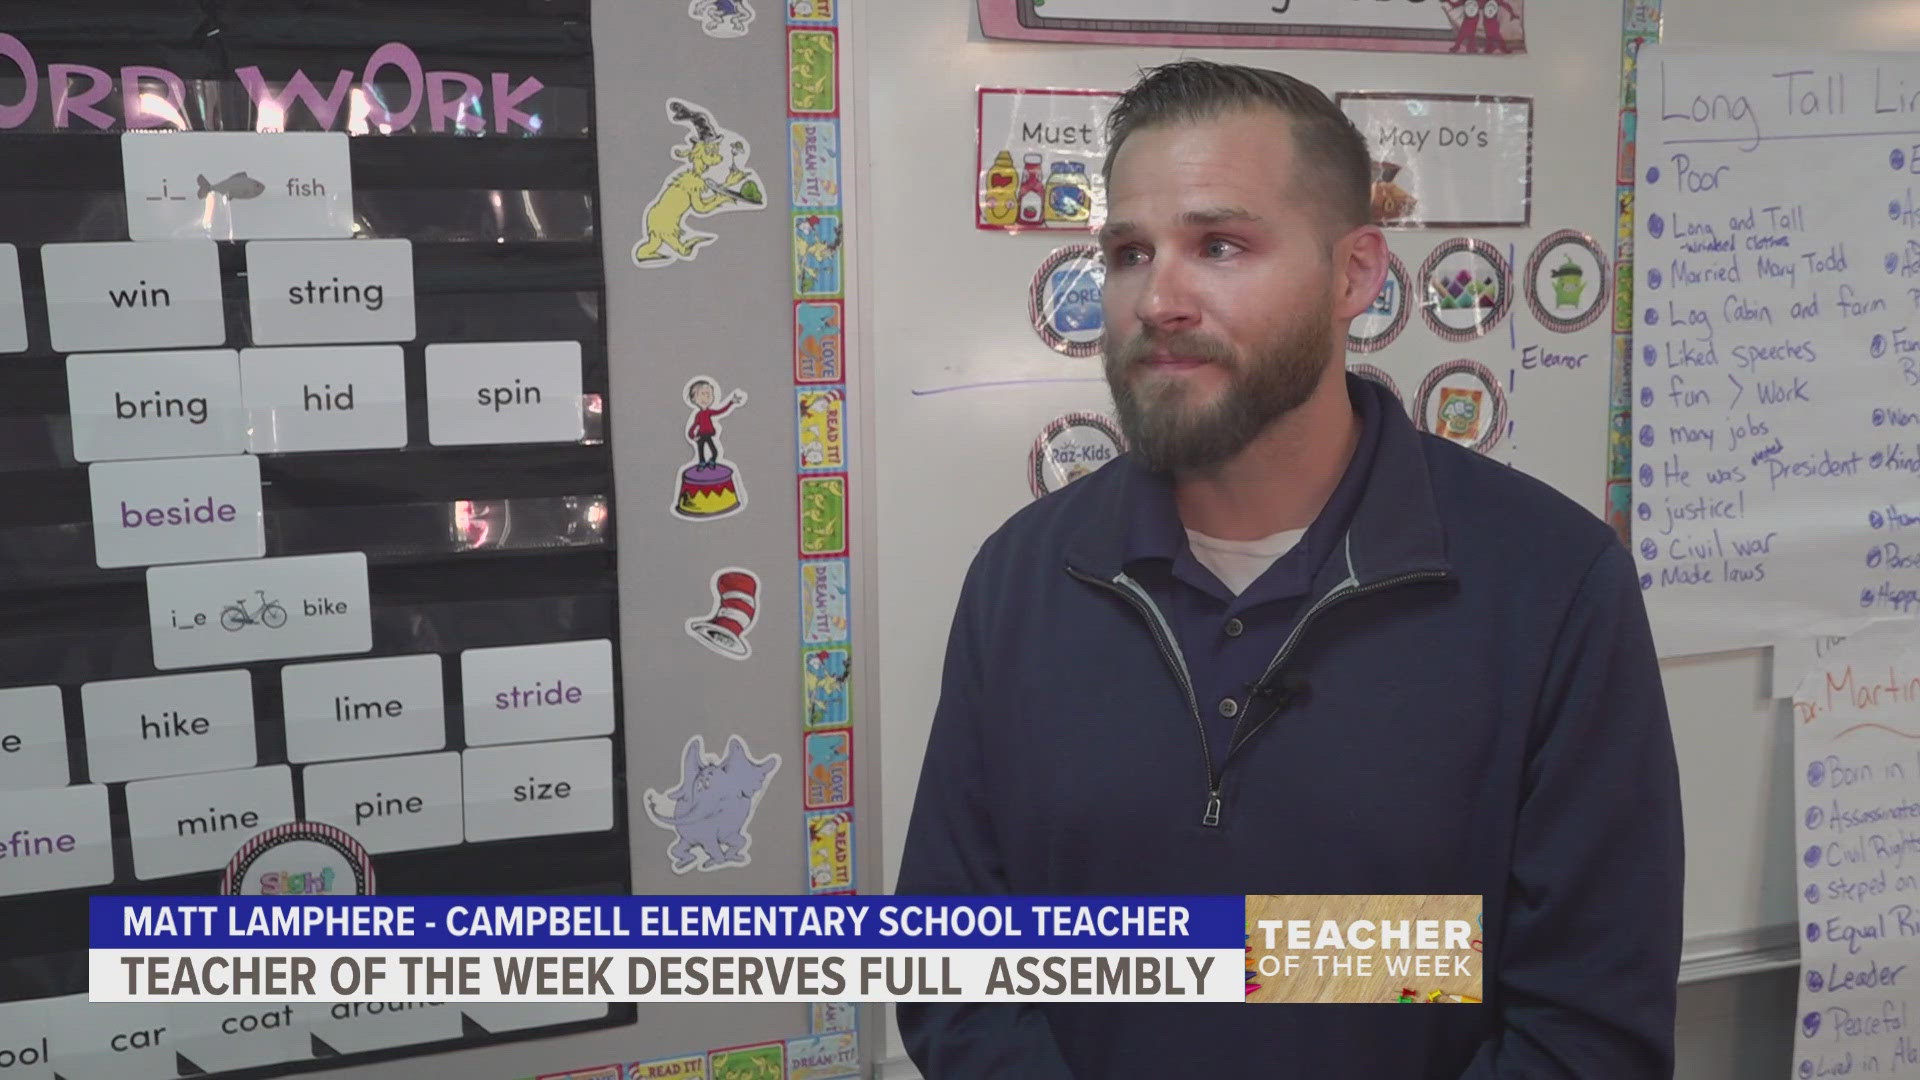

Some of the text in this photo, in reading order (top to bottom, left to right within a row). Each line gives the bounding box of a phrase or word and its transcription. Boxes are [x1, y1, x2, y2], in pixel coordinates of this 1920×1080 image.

[235, 42, 545, 133] WORK
[1661, 60, 1760, 152] Long
[1772, 70, 1845, 116] Tall
[1022, 122, 1092, 145] Must
[1379, 125, 1489, 152] May Do's
[286, 177, 326, 197] fish
[1670, 153, 1730, 193] Poor
[1672, 205, 1806, 244] Long and Tall
[1671, 242, 1848, 289] Married Mary Todd
[108, 280, 170, 309] win
[288, 277, 384, 311] string
[1056, 288, 1103, 306] CORE
[1669, 300, 1714, 342] Log
[1723, 294, 1773, 325] Cabin
[1790, 292, 1820, 320] and
[1836, 284, 1888, 318] farm
[1520, 345, 1589, 370] Eleanor
[1666, 338, 1719, 369] Liked
[115, 391, 208, 425] bring
[303, 383, 354, 412] hid
[477, 378, 541, 413] spin
[1725, 413, 1770, 451] jobs
[1052, 444, 1112, 464] Raz-Kids
[1664, 448, 1864, 492] He was President
[120, 496, 237, 529] beside
[1669, 528, 1778, 561] Civil war
[1661, 560, 1766, 588] Made laws
[303, 598, 348, 618] bike
[495, 679, 583, 710] stride
[1825, 664, 1920, 713] Martin
[335, 696, 403, 722] lime
[140, 711, 210, 741] hike
[513, 776, 572, 802] size
[177, 806, 261, 837] mine
[355, 792, 423, 826] pine
[1826, 913, 1886, 954] Equal
[1827, 960, 1907, 992] Leader
[221, 1004, 294, 1035] coat
[330, 1002, 445, 1020] arou
[110, 1025, 167, 1052] car
[649, 1063, 681, 1079] READ
